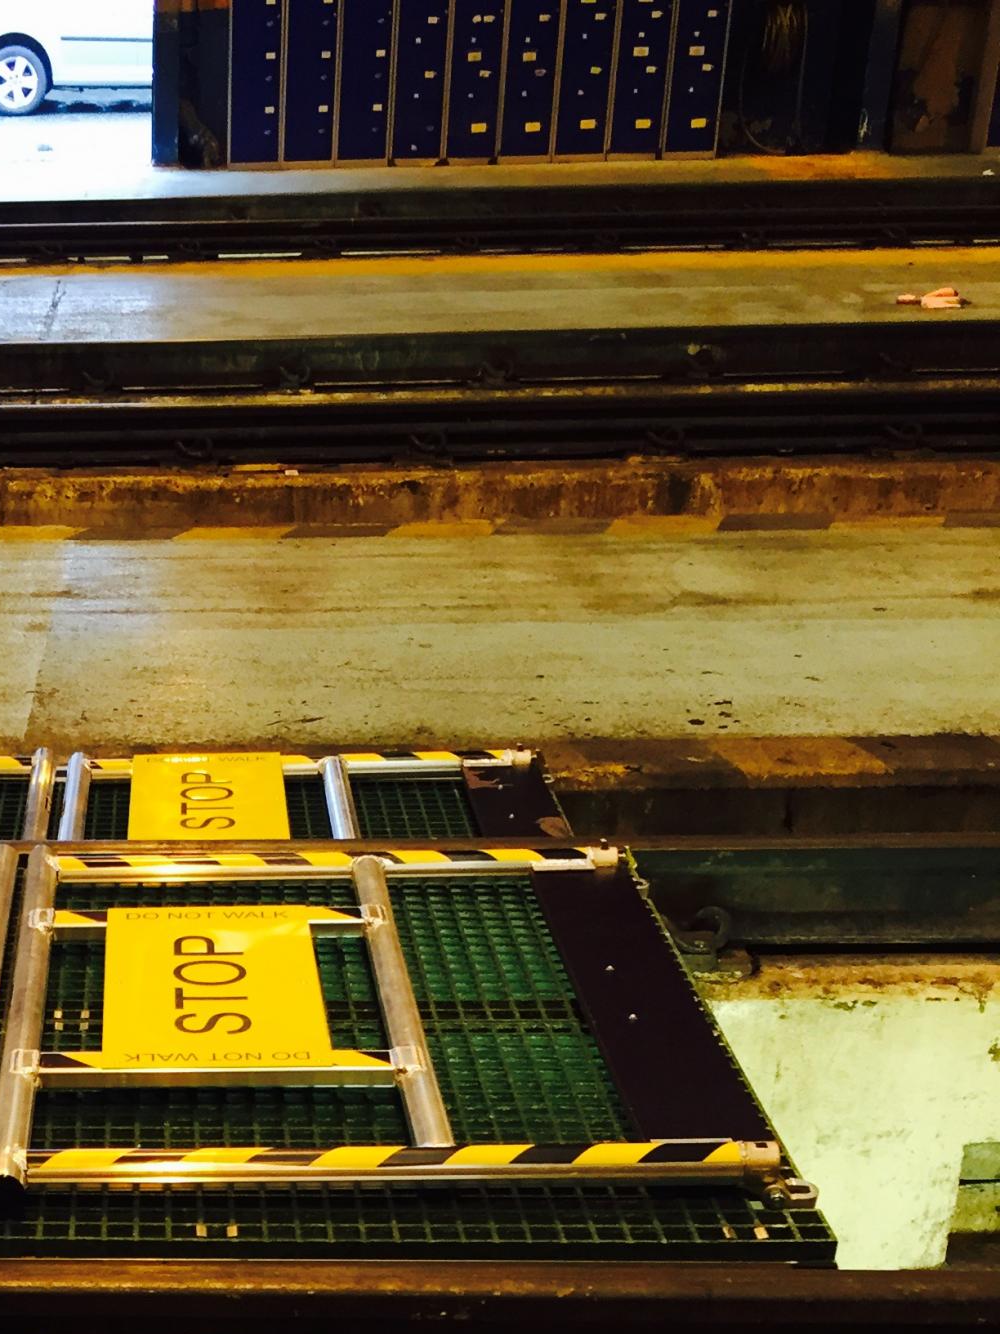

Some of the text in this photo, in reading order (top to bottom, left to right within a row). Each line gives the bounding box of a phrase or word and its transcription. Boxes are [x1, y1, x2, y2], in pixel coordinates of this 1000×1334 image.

[180, 773, 235, 829] STOP
[125, 911, 288, 921] DO NOT WALK
[173, 936, 252, 1034] STOP
[125, 1051, 311, 1063] DO NOT WALK
